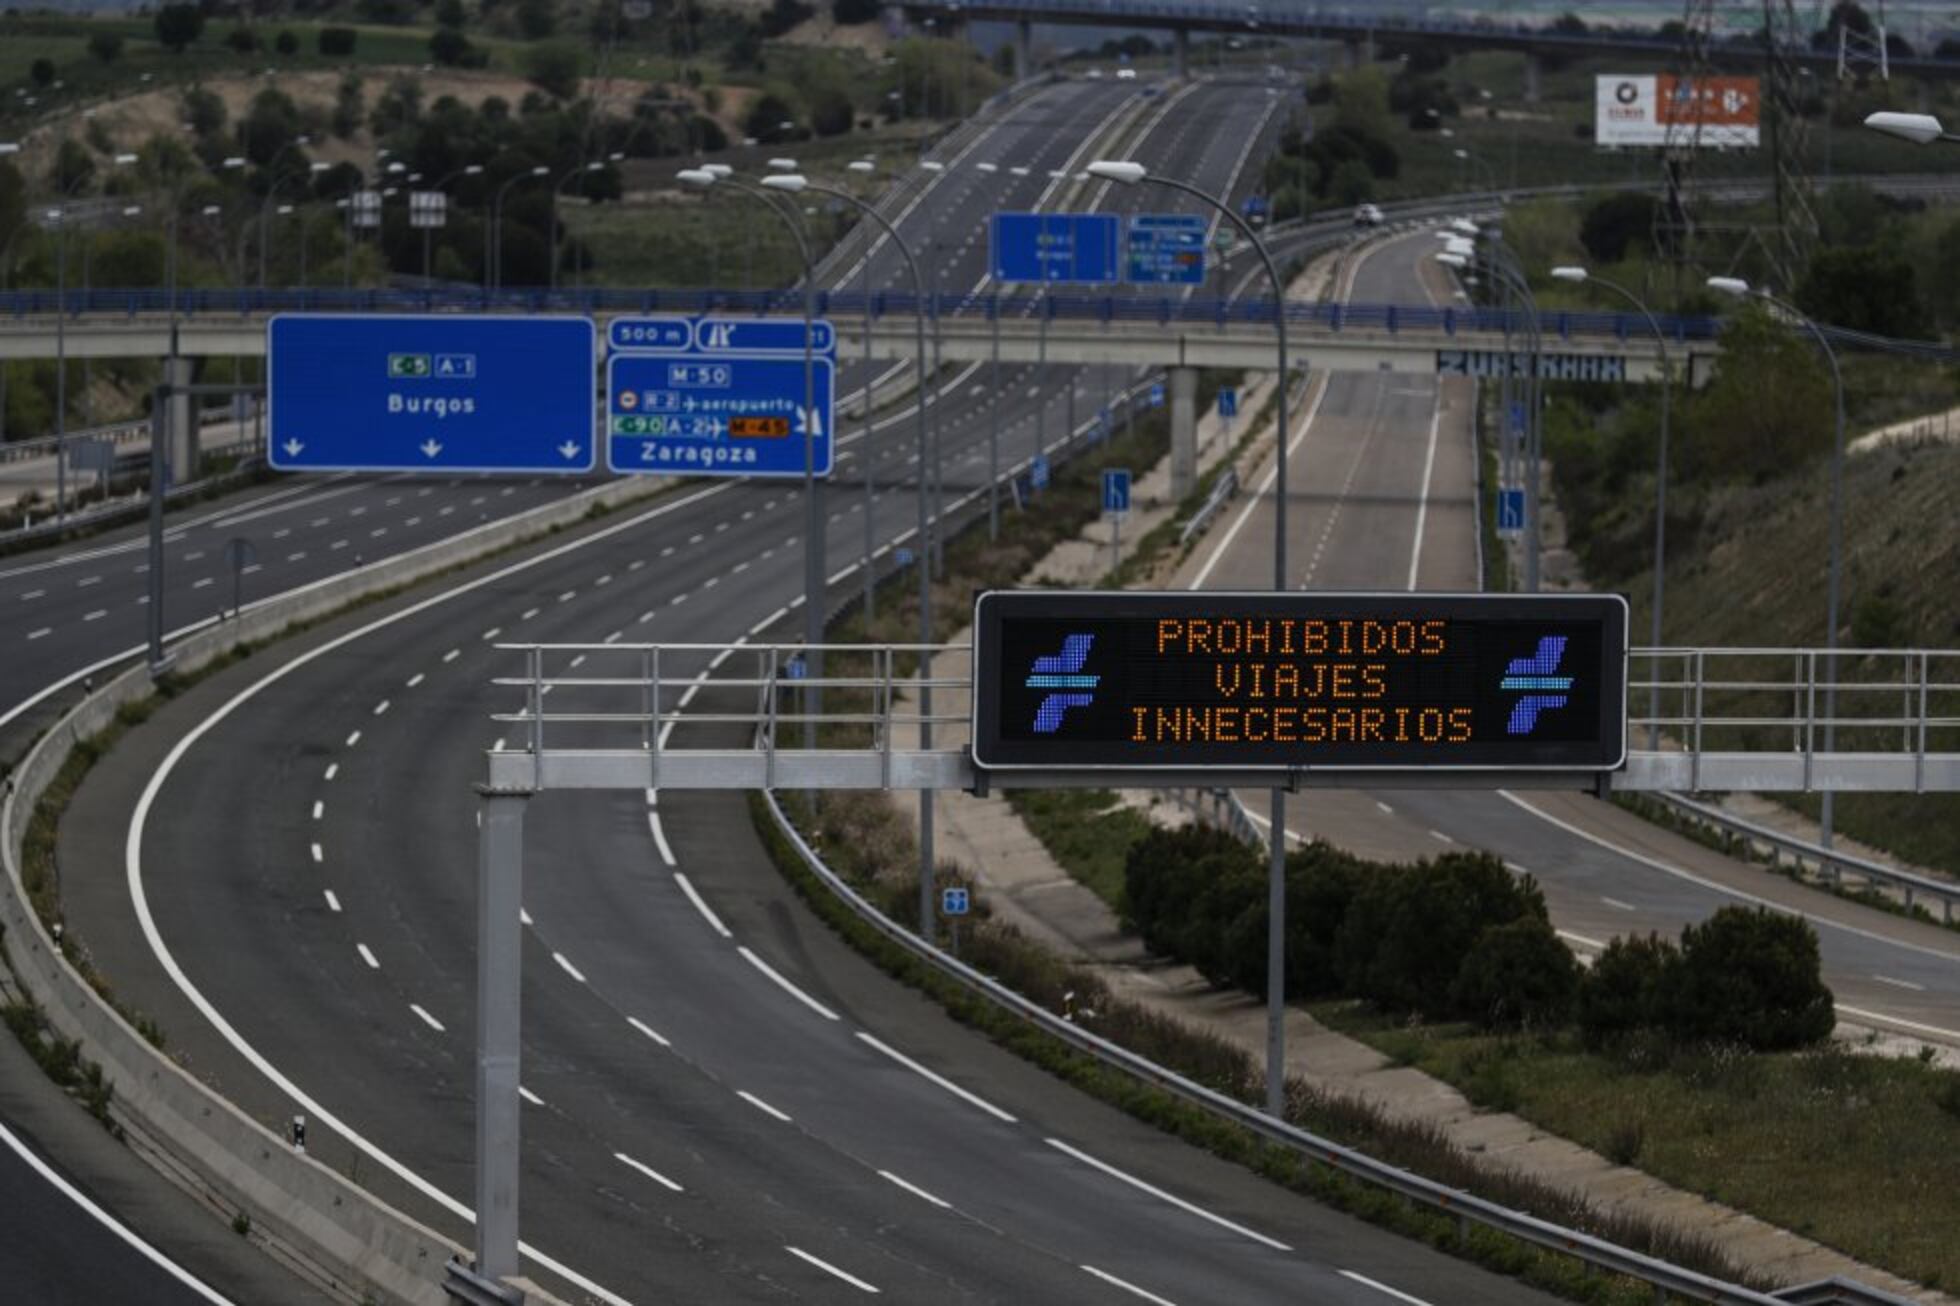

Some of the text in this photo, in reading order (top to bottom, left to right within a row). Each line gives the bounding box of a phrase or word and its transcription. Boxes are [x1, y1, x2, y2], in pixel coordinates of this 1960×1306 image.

[620, 327, 680, 341] 500 m
[441, 358, 471, 374] A-1
[673, 367, 726, 383] M-50
[388, 394, 475, 418] Burgos
[701, 398, 795, 413] aeropuerto
[640, 441, 757, 466] Zaragoza
[1158, 619, 1447, 655] PROHIBIDOS
[1216, 664, 1387, 698] VIAJES
[1131, 706, 1473, 742] INNECESARIOS
